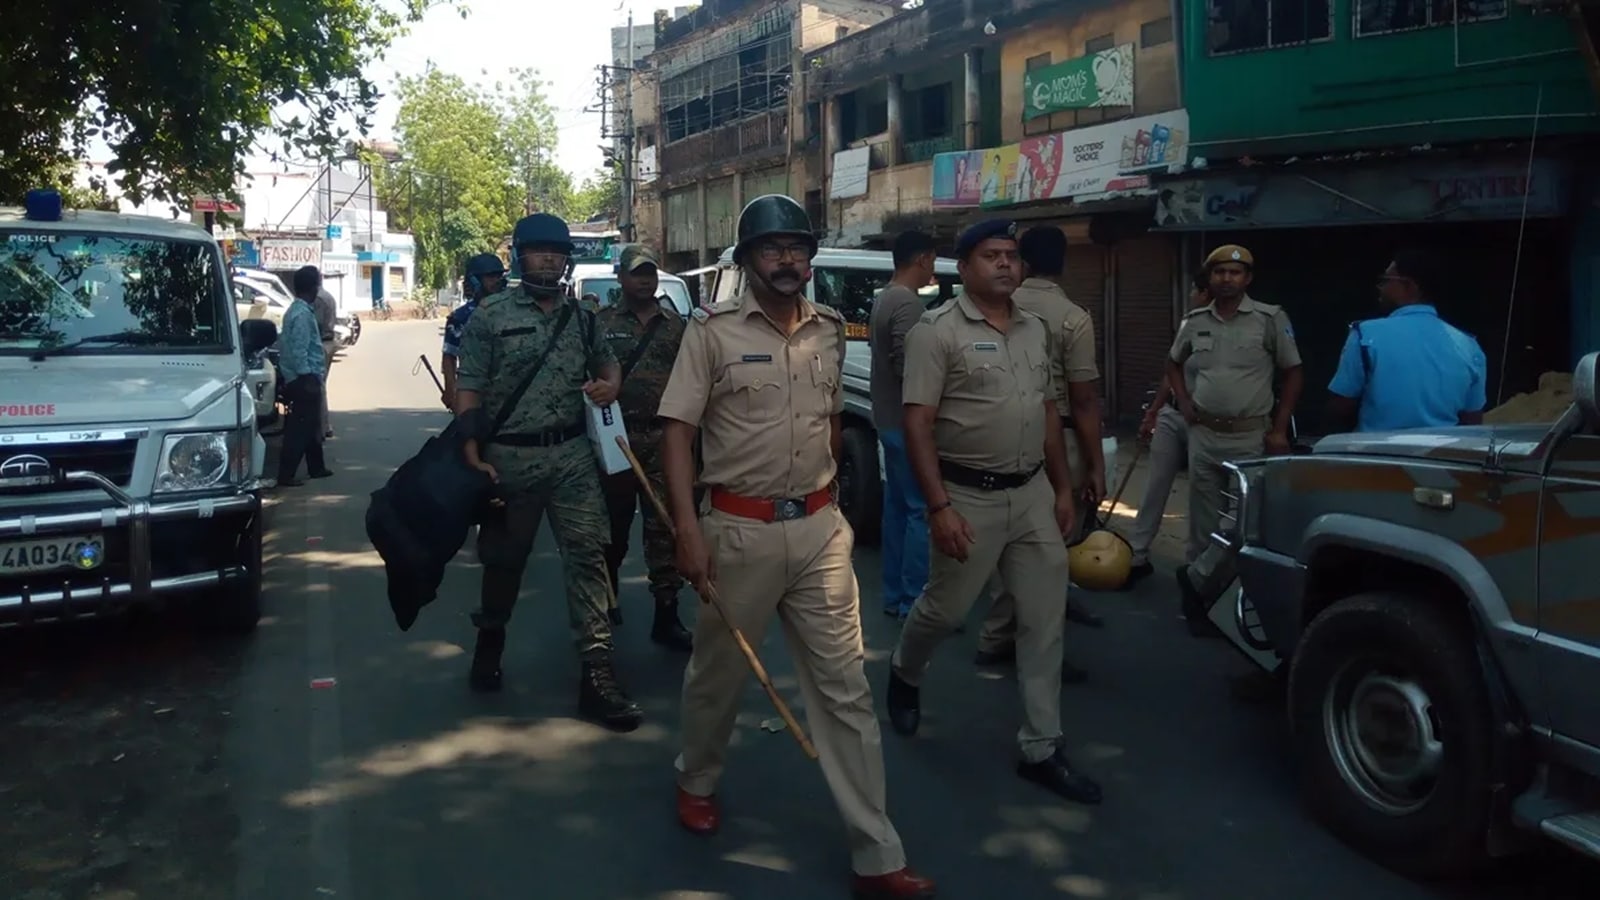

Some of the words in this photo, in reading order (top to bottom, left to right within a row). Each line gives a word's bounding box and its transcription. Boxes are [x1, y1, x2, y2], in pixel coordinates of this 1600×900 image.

[1051, 70, 1087, 91] MOM'S
[1053, 87, 1086, 104] MAGIC
[1075, 152, 1099, 163] CHOICE
[9, 235, 56, 243] POLICE
[263, 246, 319, 262] FASHION
[845, 324, 868, 337] LICE
[0, 404, 55, 416] POLICE
[2, 432, 80, 442] OLD
